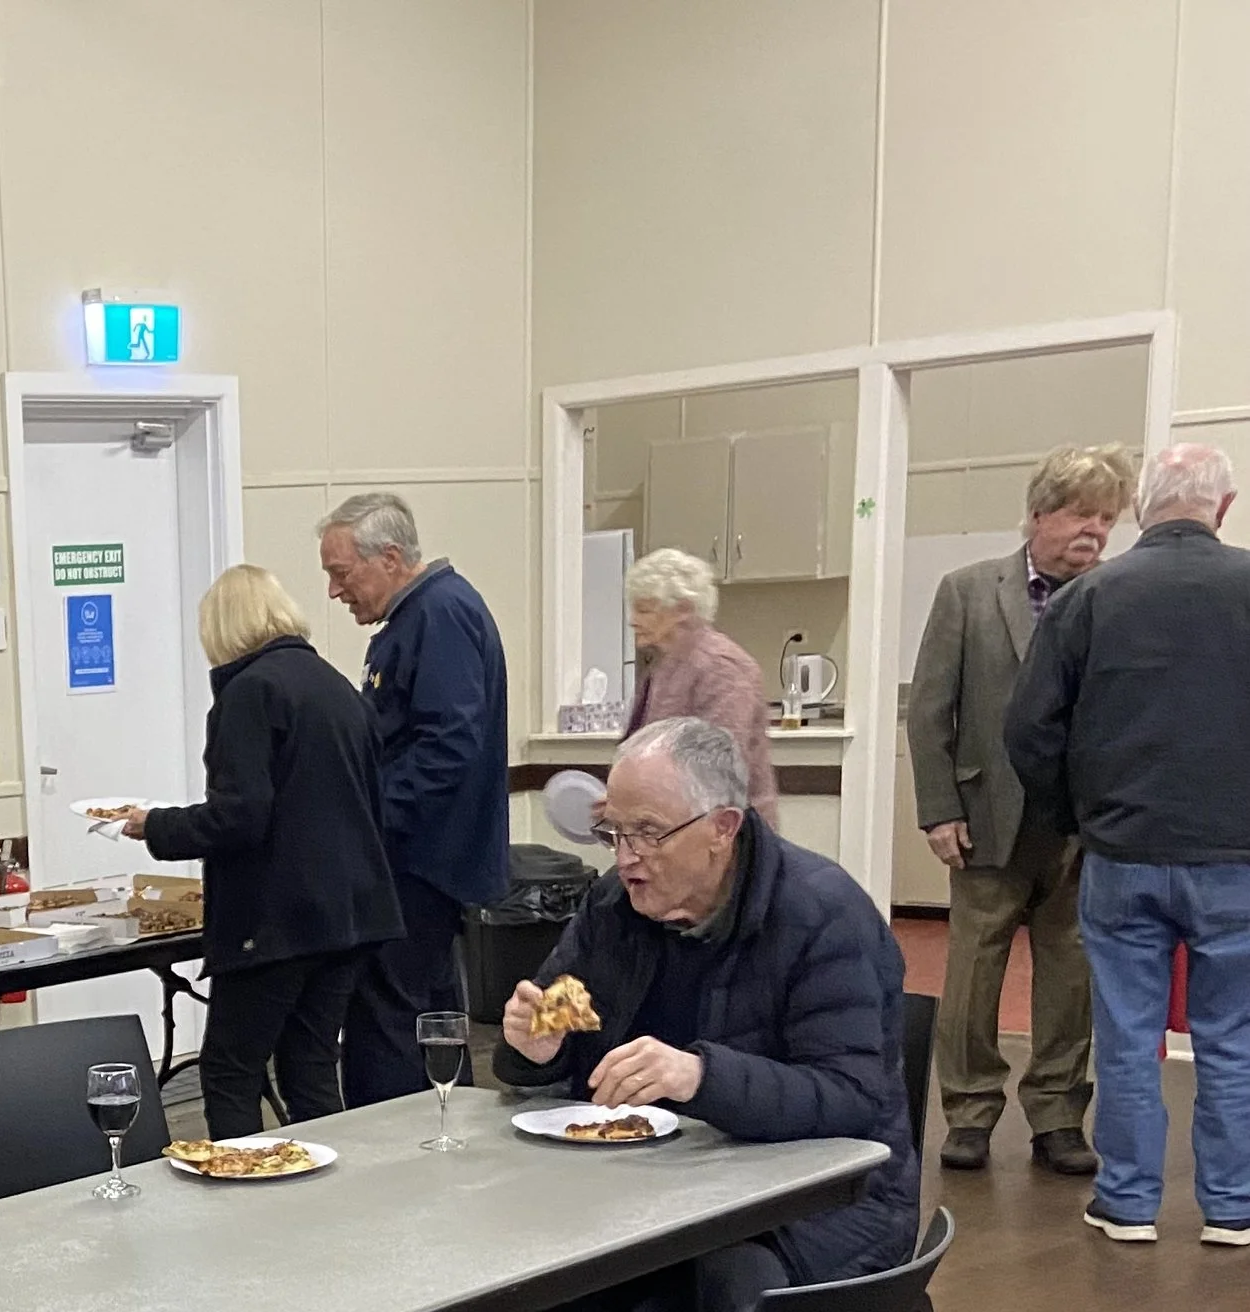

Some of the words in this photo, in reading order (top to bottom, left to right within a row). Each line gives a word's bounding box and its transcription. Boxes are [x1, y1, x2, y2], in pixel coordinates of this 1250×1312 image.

[54, 550, 103, 565] EMERGENCY
[104, 550, 122, 563] EXIT
[55, 568, 66, 580] DO
[67, 567, 82, 580] NOT
[83, 566, 122, 579] OBSTRUCT
